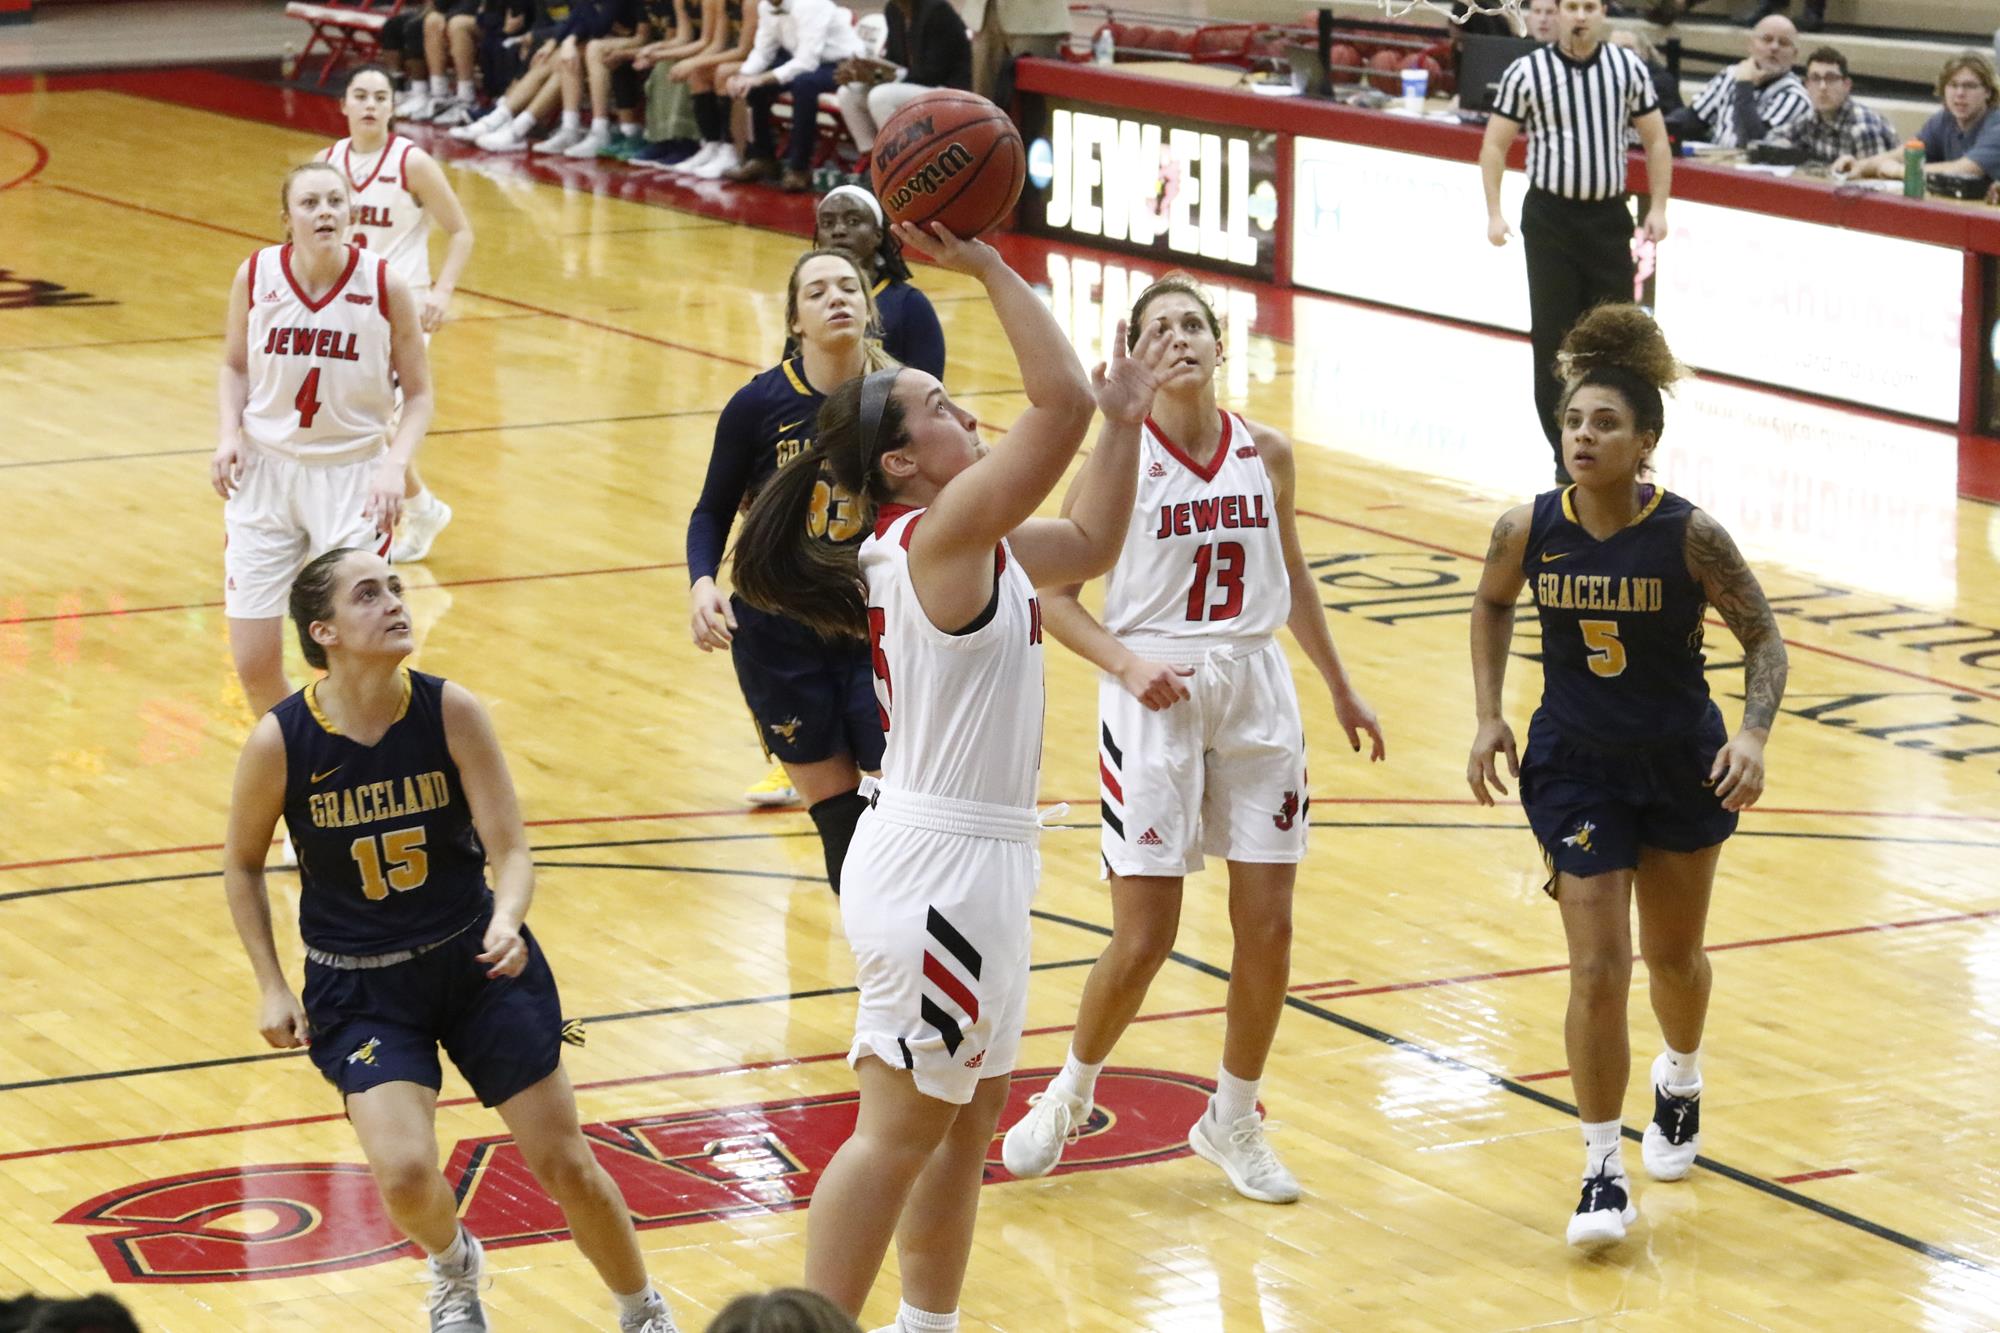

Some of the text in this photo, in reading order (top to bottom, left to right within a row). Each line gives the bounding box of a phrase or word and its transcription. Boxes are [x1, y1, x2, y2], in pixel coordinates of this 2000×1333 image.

[888, 142, 974, 212] Wilson
[1046, 109, 1258, 266] JEWELL
[264, 327, 360, 361] JEWELL
[295, 367, 321, 428] 4
[1157, 494, 1269, 540] JEWELL
[1186, 541, 1245, 622] 13
[1538, 572, 1663, 612] GRACELAND
[1578, 619, 1628, 678] 5
[309, 770, 450, 829] GRACELAND
[350, 825, 429, 901] 15
